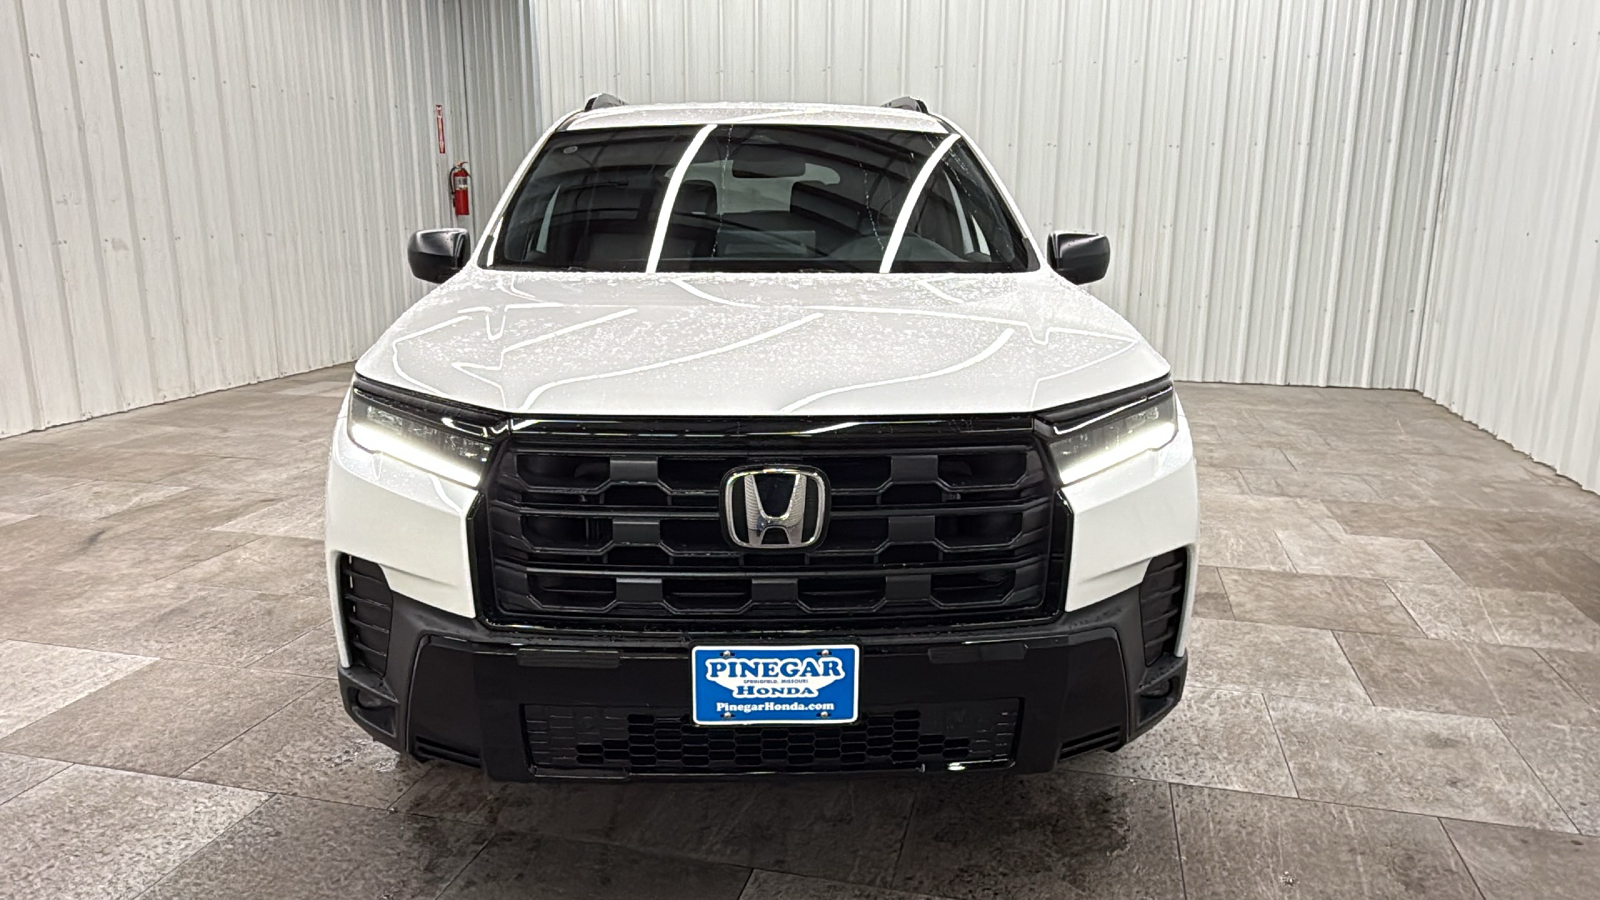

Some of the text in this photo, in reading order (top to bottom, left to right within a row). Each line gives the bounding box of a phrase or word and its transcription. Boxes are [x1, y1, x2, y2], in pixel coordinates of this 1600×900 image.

[709, 660, 841, 677] PINEGAR
[736, 686, 814, 695] HONDA
[716, 702, 835, 713] PinegarHonda.com
